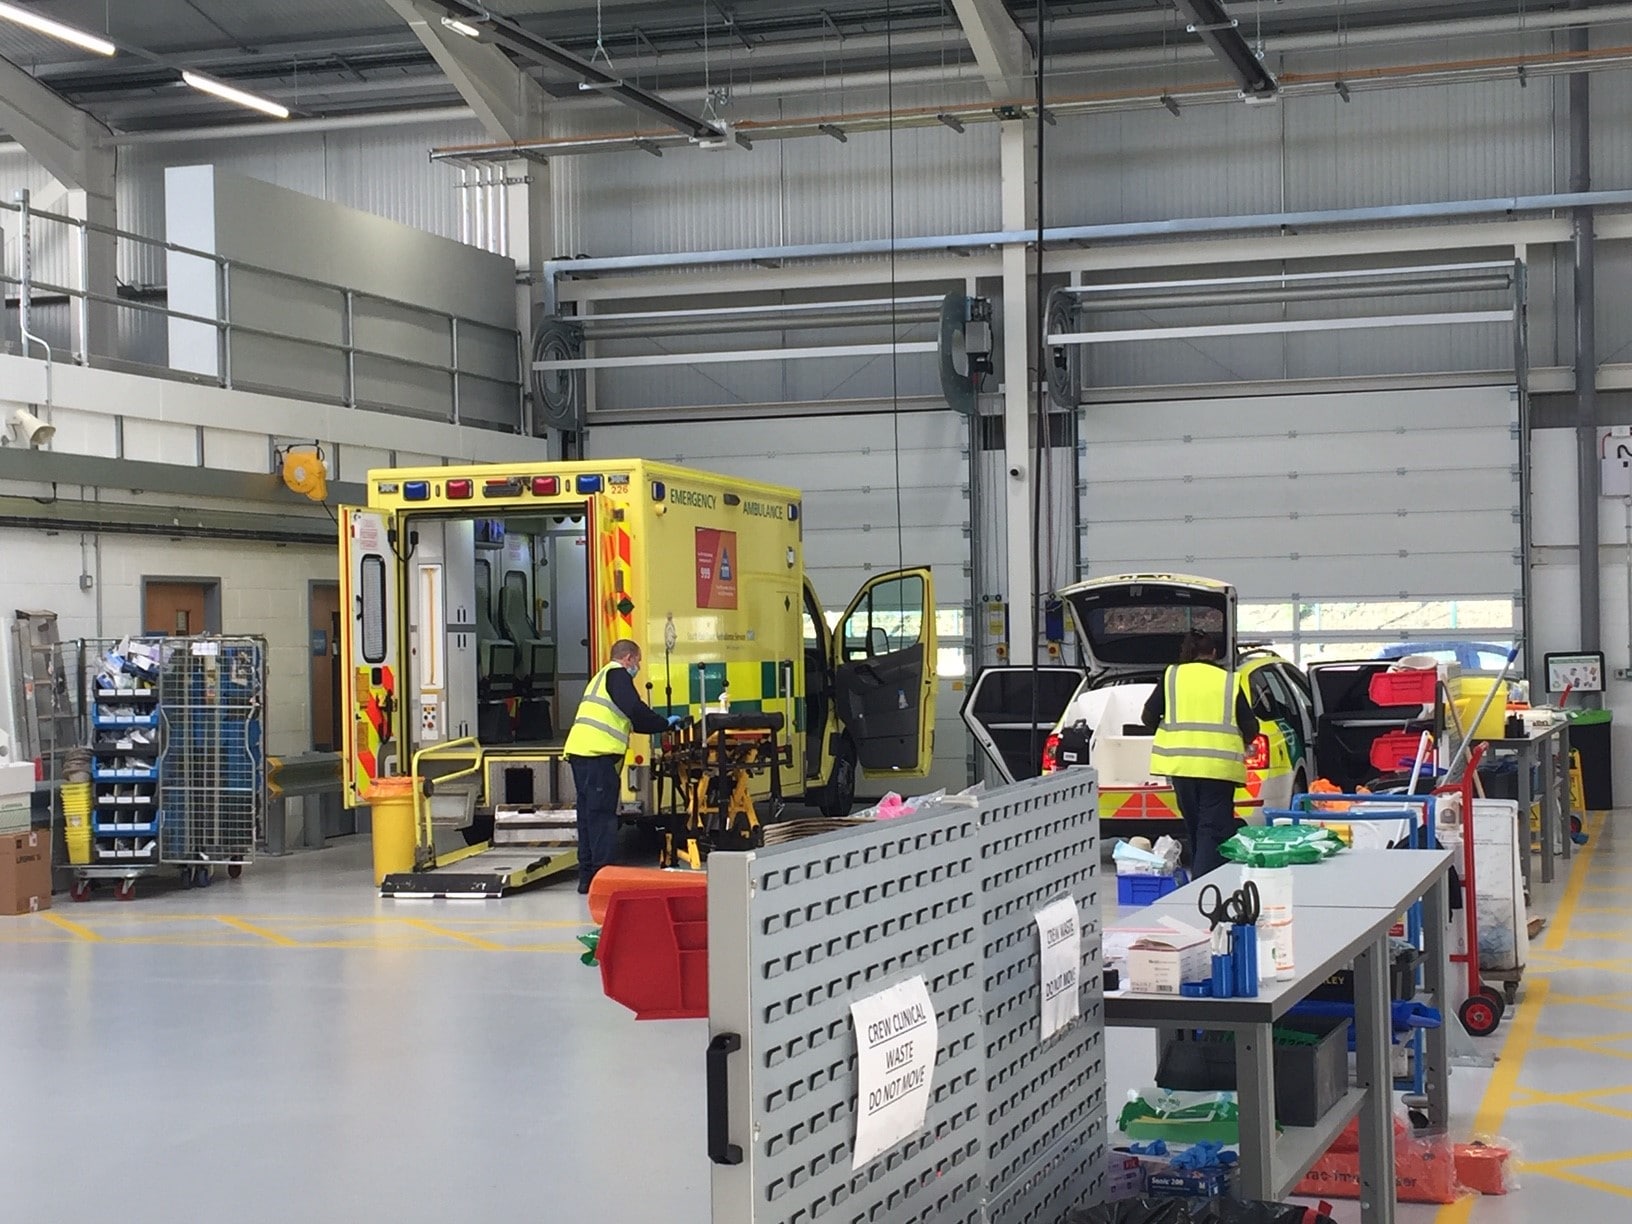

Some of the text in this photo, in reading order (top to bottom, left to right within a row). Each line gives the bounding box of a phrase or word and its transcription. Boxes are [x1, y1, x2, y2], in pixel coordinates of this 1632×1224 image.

[611, 485, 629, 494] 226
[670, 488, 783, 520] EMERGENCY AMBULANCE
[868, 1003, 926, 1044] CREW CLINICAL
[885, 1041, 914, 1069] WASTE
[869, 1065, 926, 1111] DO NOT MOVE
